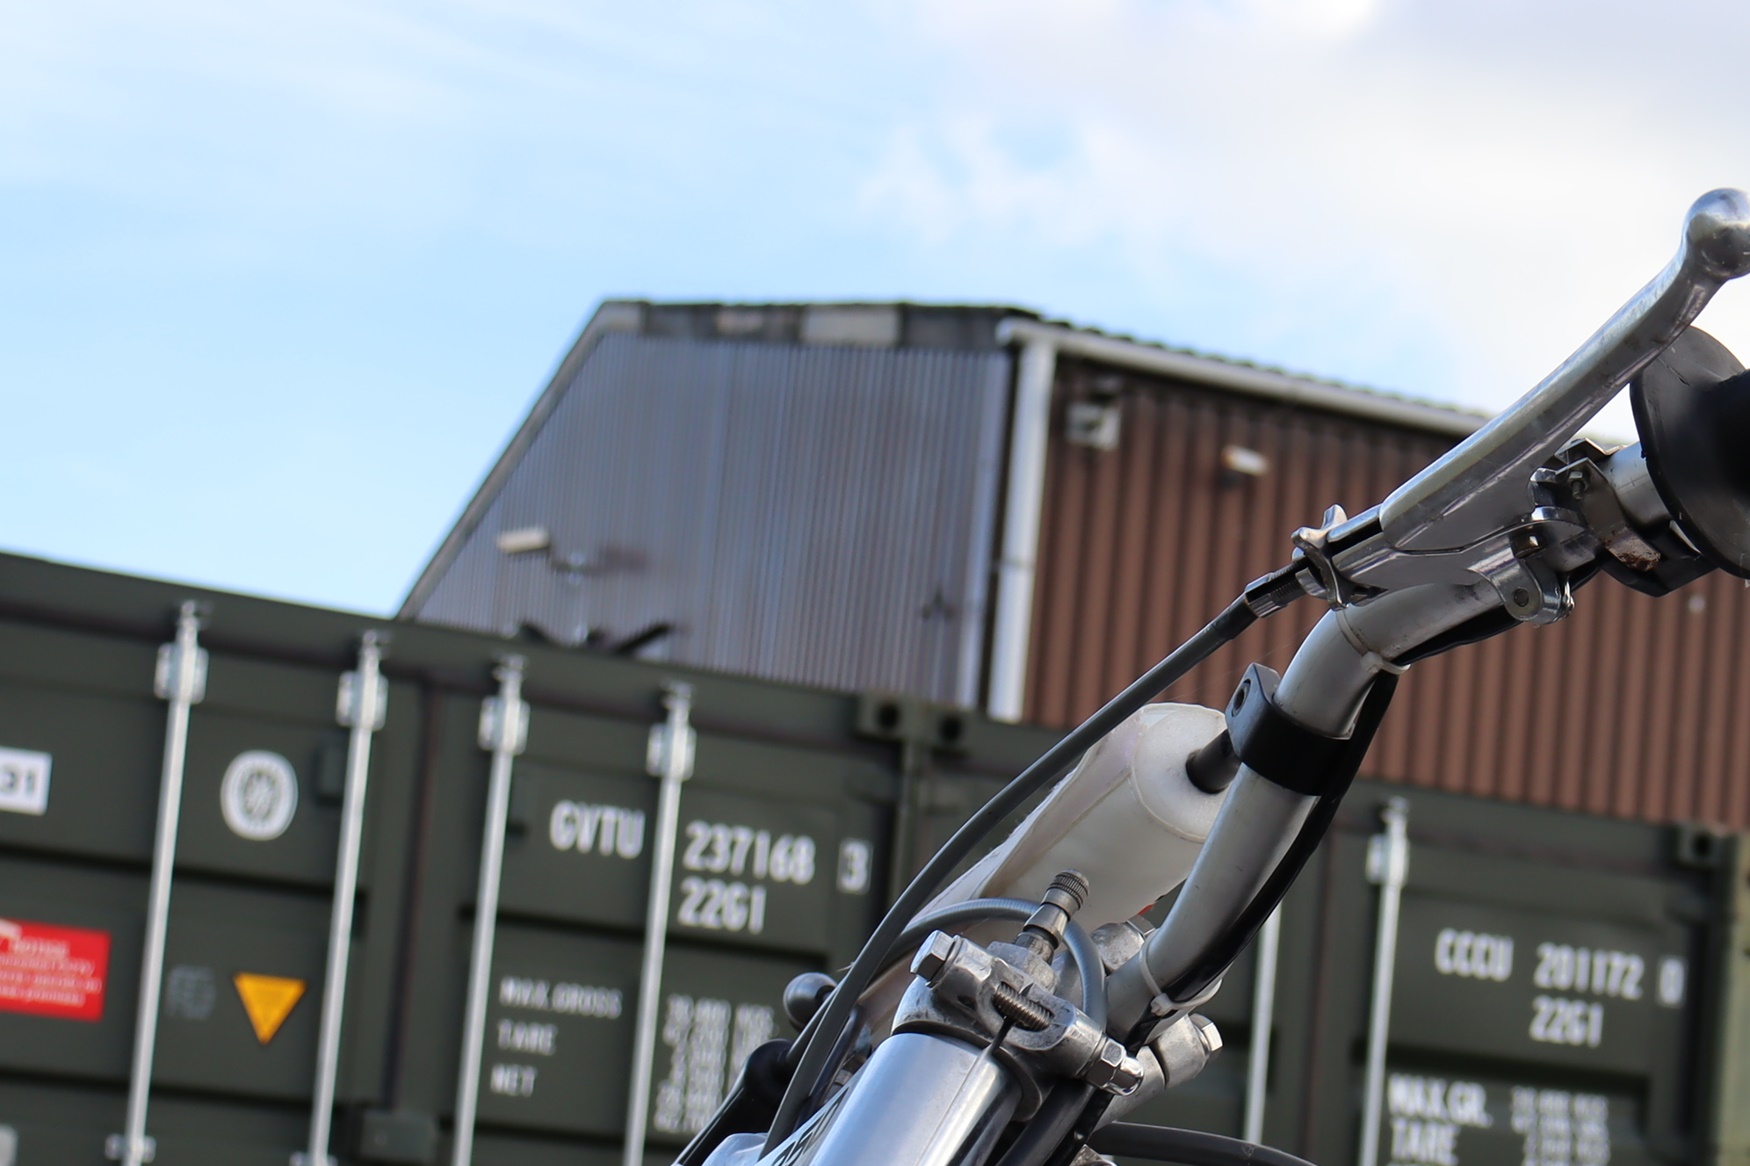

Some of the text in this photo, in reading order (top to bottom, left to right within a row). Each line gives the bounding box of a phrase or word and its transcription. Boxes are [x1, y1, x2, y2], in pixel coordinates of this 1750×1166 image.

[550, 801, 870, 892] GVTU 237168 3
[1434, 927, 1514, 982] CCCU
[1533, 942, 1645, 1000] 201172
[497, 1019, 558, 1056] TARE
[490, 1064, 537, 1097] NET
